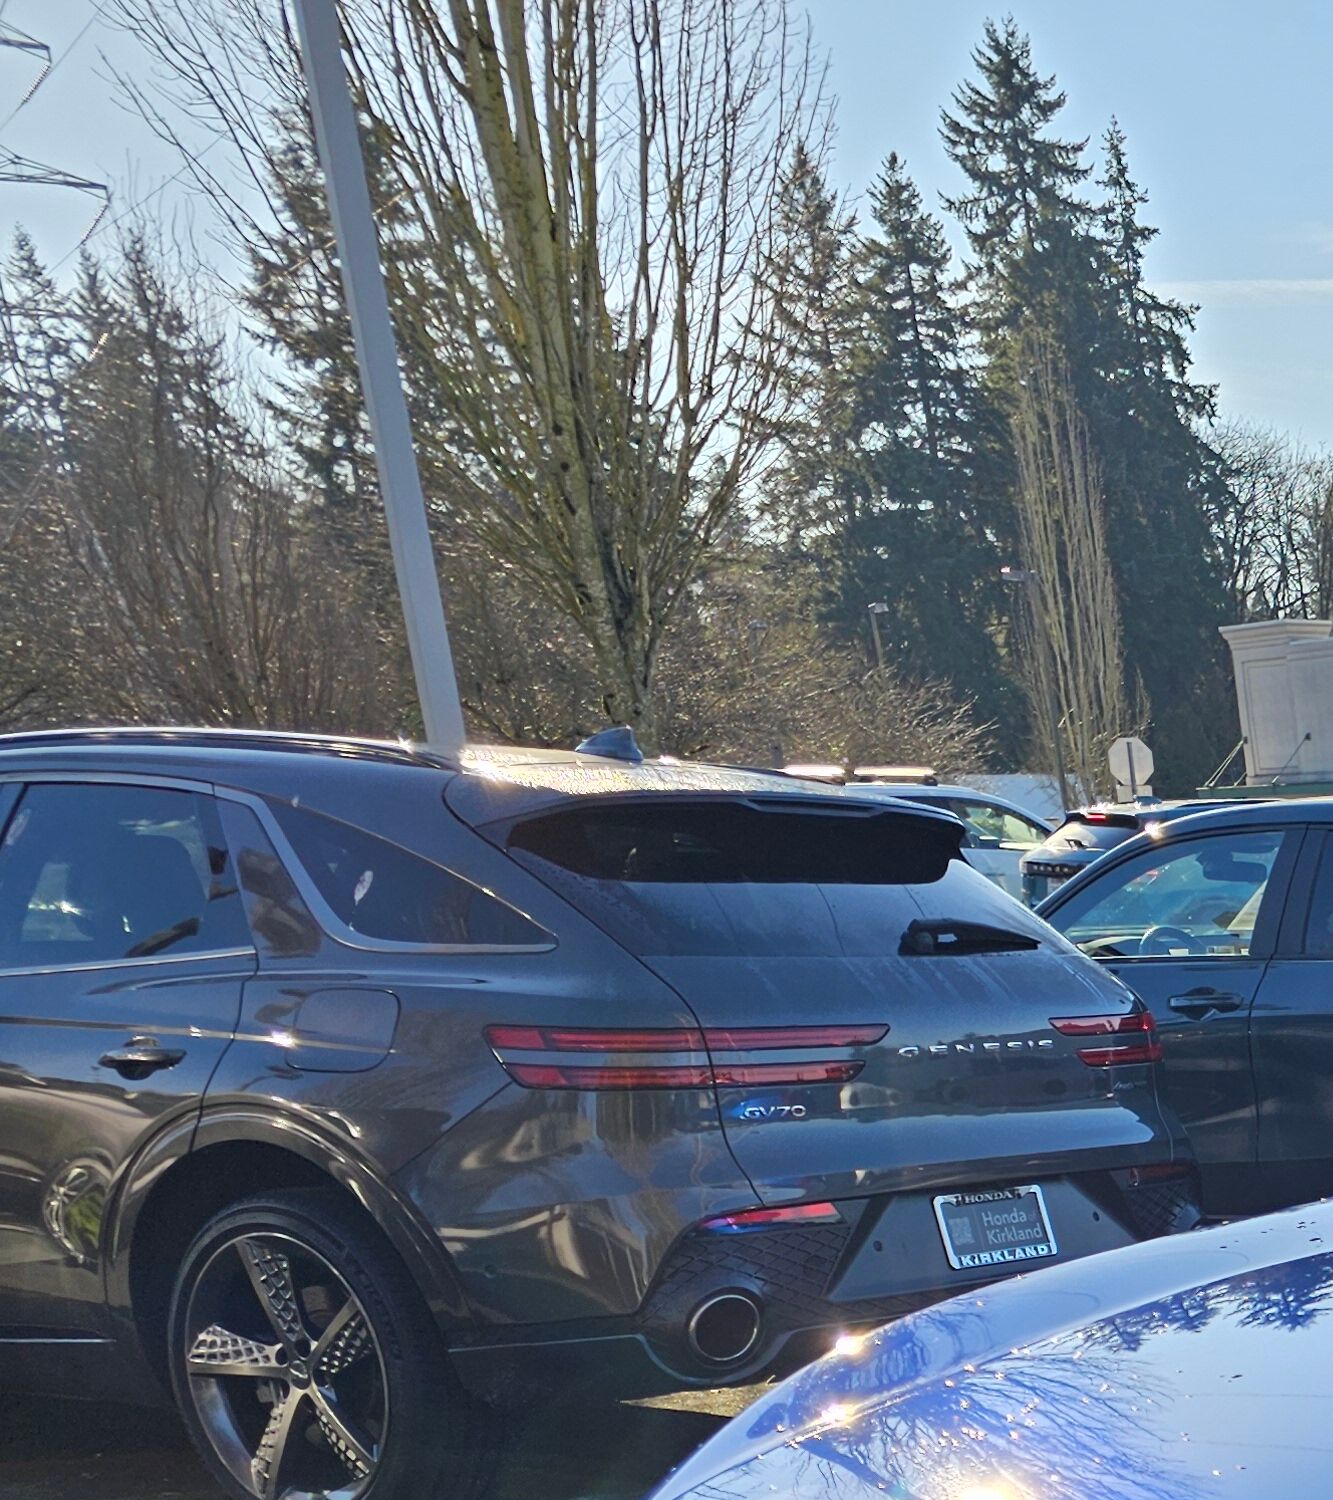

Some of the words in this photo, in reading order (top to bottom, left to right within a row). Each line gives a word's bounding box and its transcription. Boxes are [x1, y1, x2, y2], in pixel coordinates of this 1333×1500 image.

[898, 1039, 1053, 1057] GENESIS
[744, 1105, 806, 1119] GV70
[964, 1191, 1013, 1204] HONDA
[982, 1208, 1027, 1226] Honda
[986, 1223, 1043, 1245] Kirkland
[961, 1244, 1049, 1266] KIRKLAND
